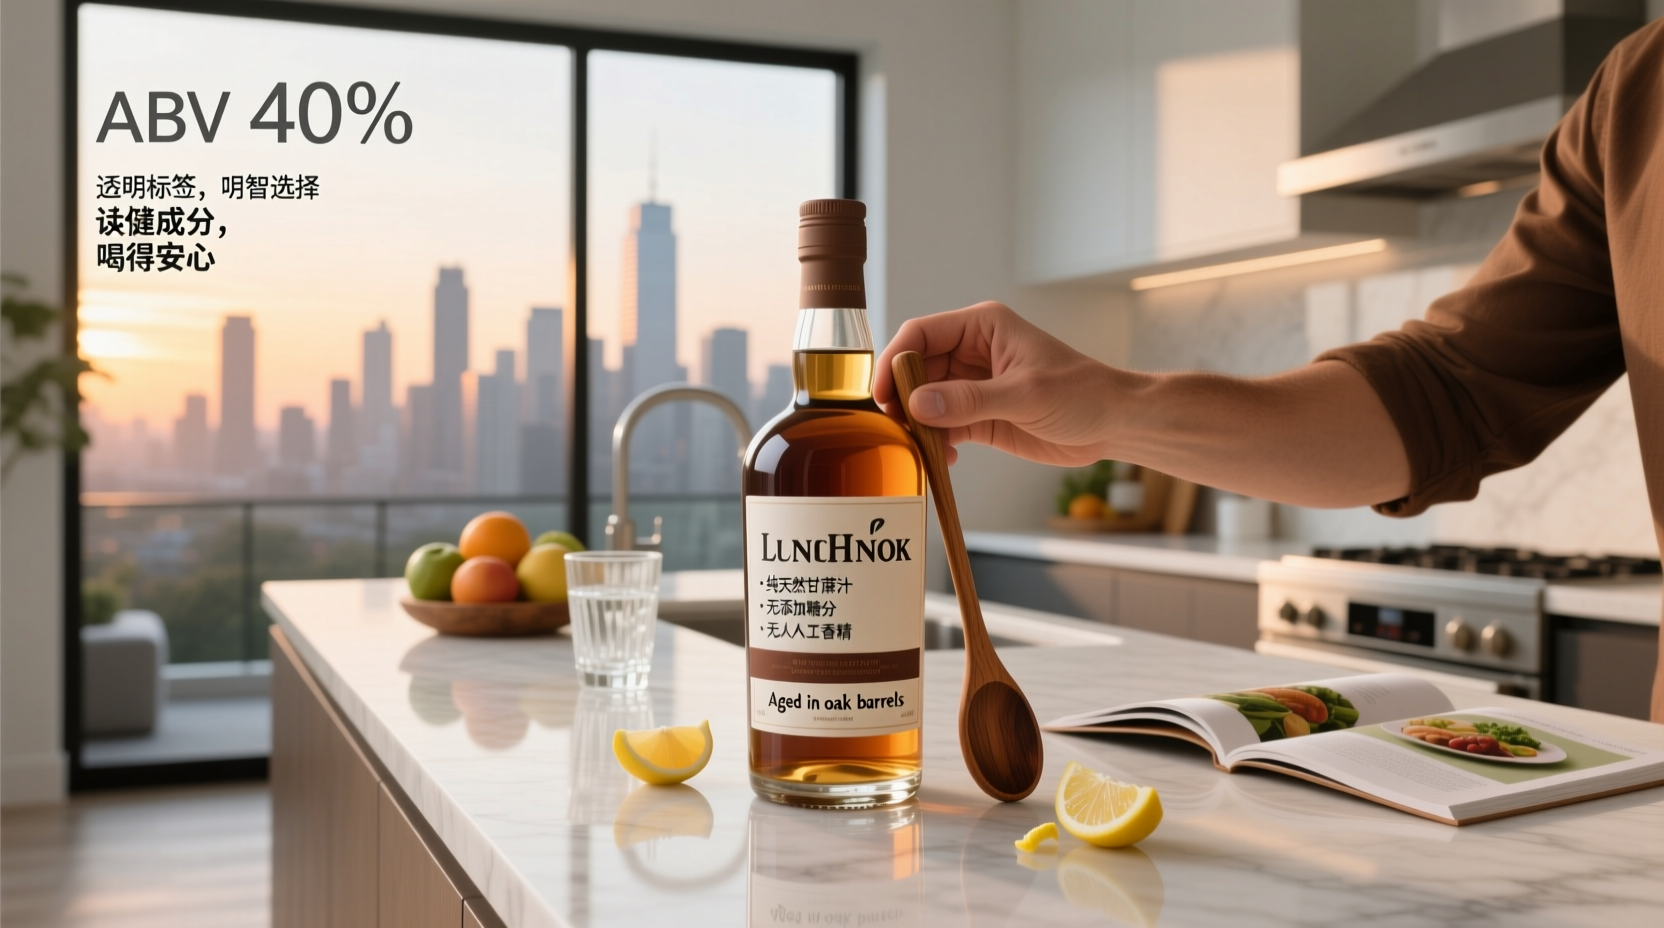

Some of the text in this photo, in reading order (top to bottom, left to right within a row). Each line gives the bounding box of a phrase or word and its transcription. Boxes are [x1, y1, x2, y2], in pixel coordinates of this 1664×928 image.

[768, 691, 905, 713] Aged in oak barrels
